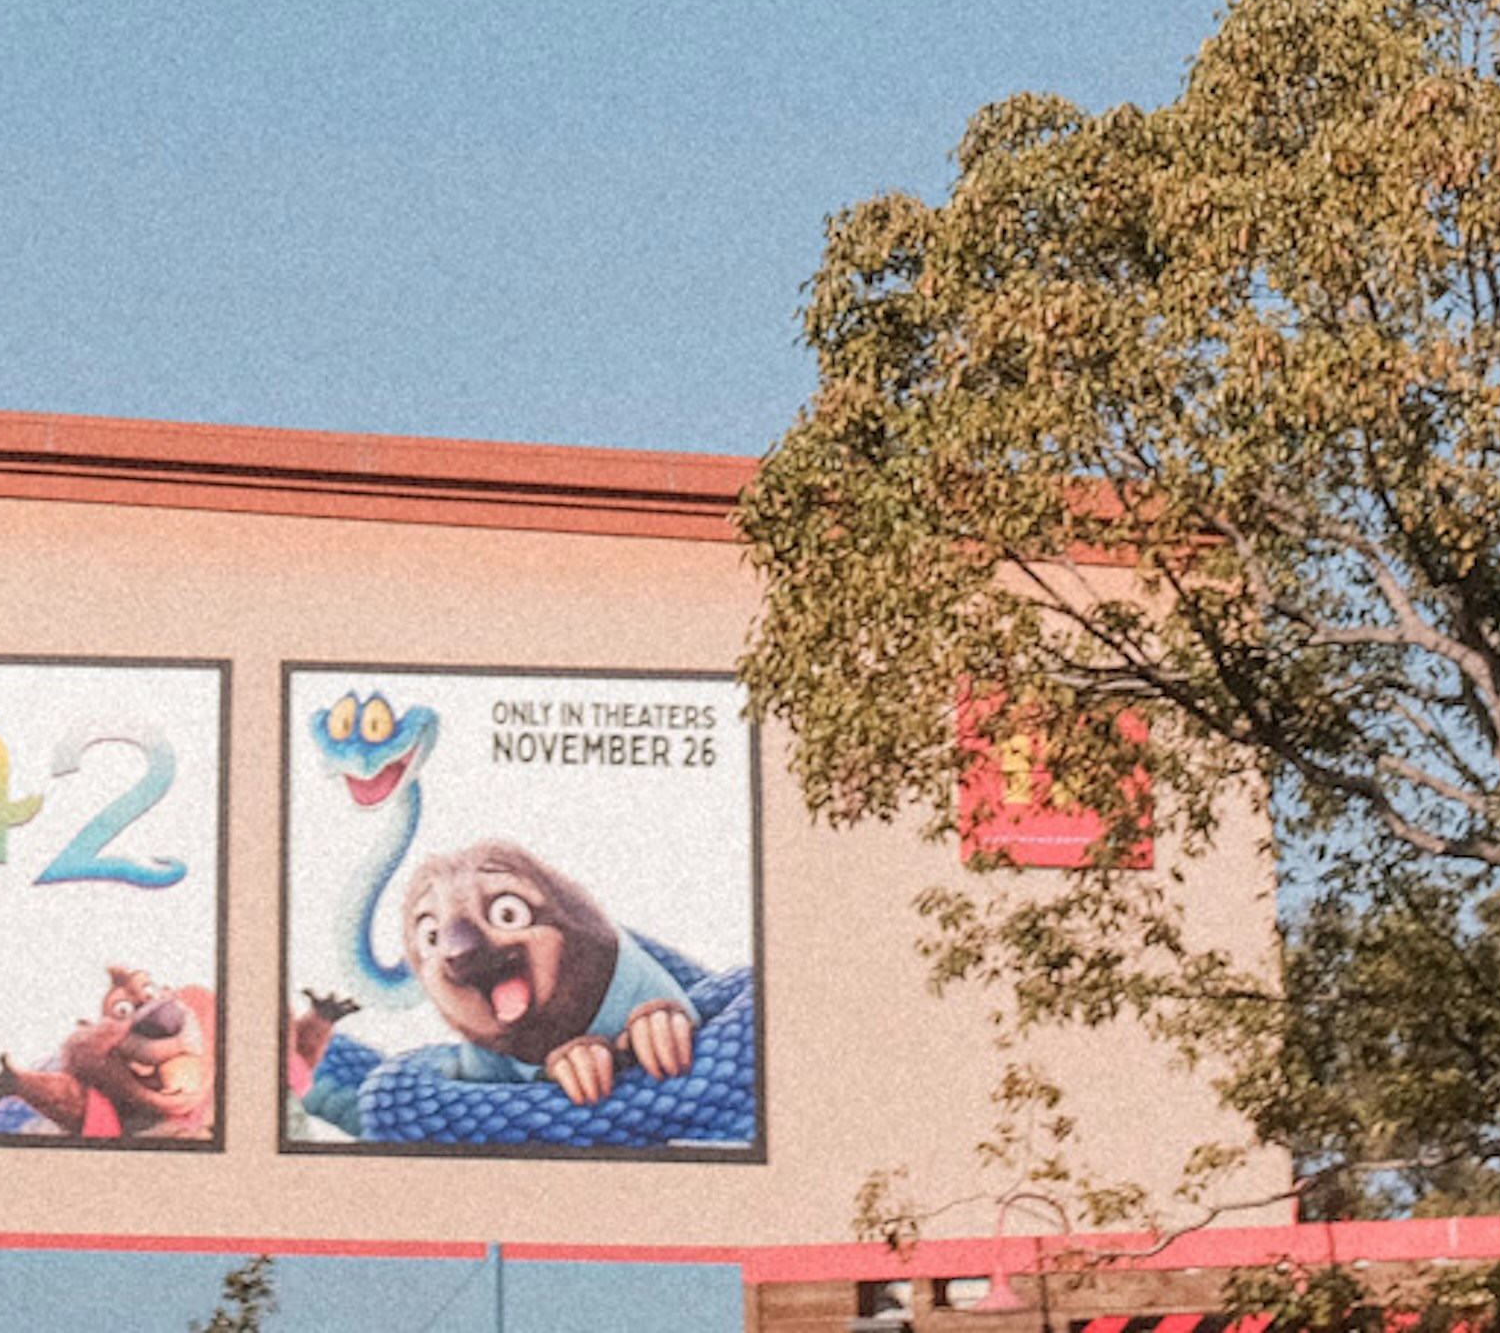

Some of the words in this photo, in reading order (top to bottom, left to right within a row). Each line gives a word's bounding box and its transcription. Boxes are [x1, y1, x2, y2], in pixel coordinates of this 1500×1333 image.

[492, 701, 551, 725] ONLY
[561, 702, 583, 727] IN
[592, 703, 716, 730] THEATERS
[492, 733, 670, 766] NOVEMBER
[683, 736, 716, 767] 26
[33, 716, 188, 888] 2
